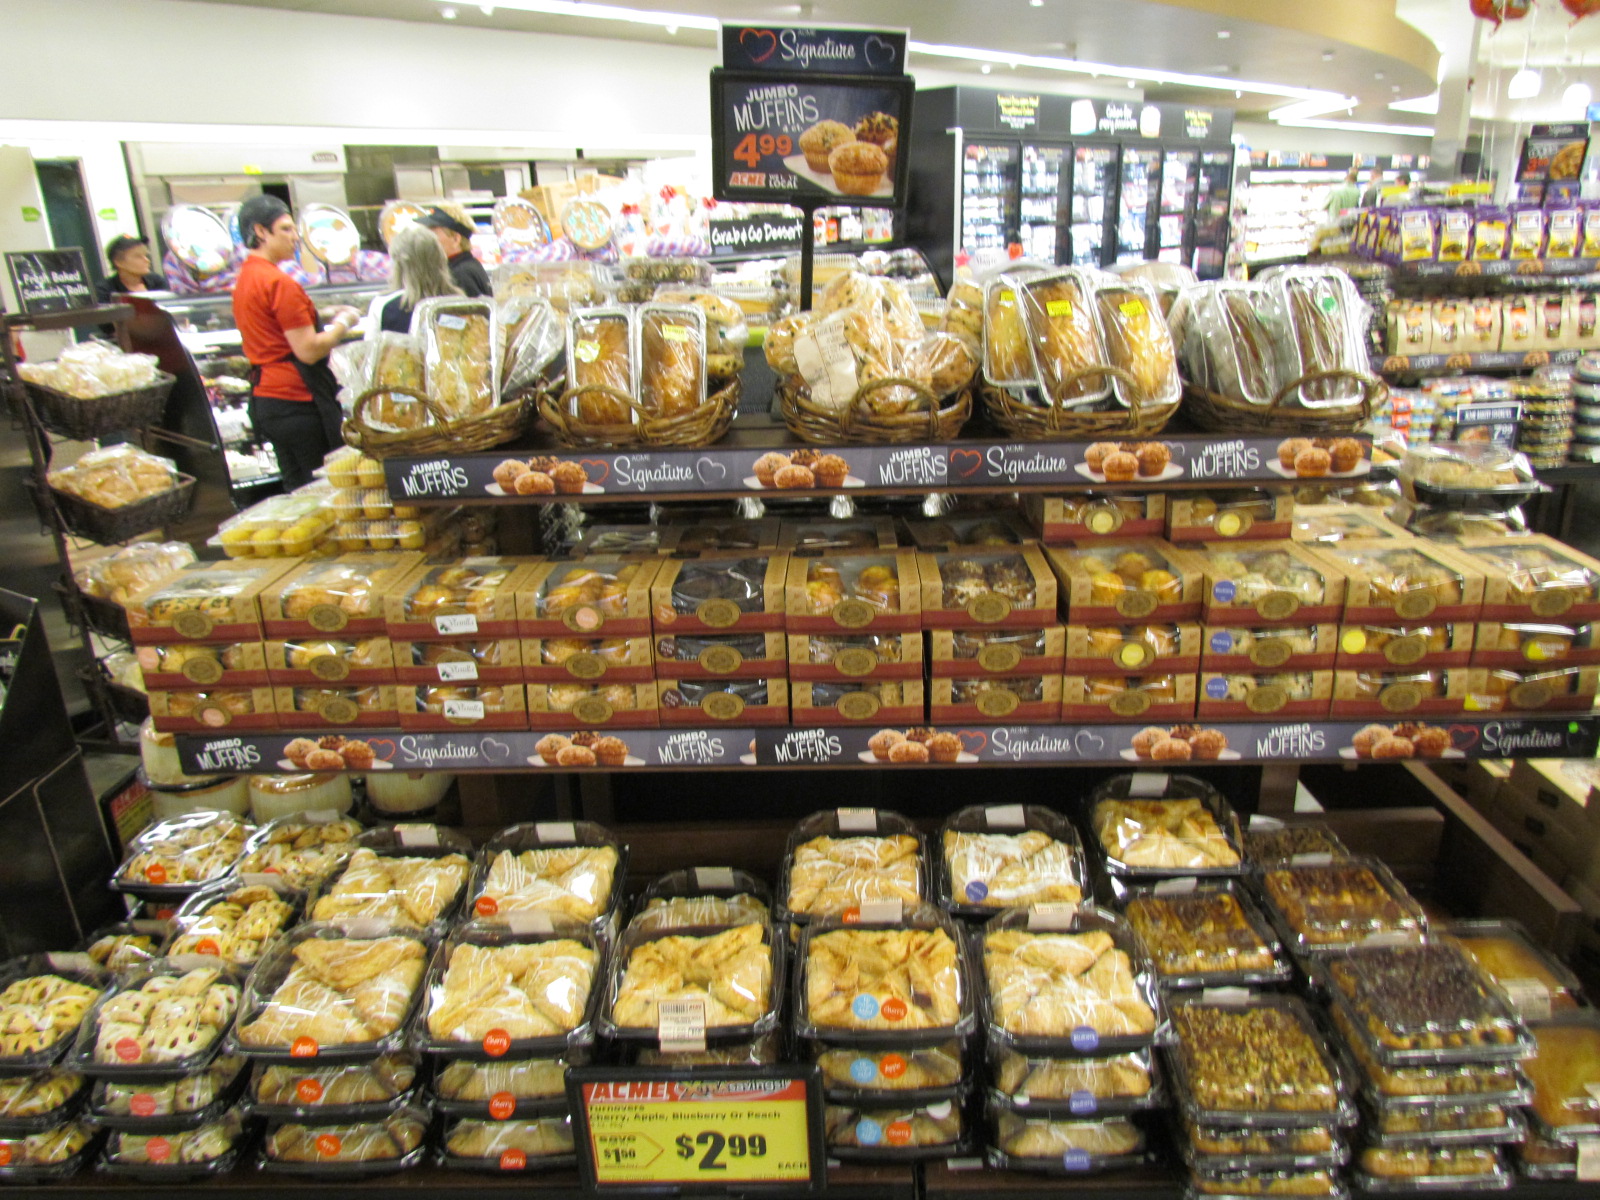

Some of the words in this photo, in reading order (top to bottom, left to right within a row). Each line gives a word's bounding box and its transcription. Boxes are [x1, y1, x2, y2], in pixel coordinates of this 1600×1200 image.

[779, 28, 856, 69] Signature
[745, 84, 798, 102] JUMBO
[733, 95, 819, 132] MUFFINS
[733, 133, 793, 167] 499
[712, 225, 740, 246] Grab
[748, 224, 762, 243] Go
[22, 272, 50, 286] Fresh
[51, 269, 82, 283] Baked
[890, 447, 931, 463] JUMBO
[1202, 439, 1244, 456] JUMBO
[411, 459, 450, 475] JUMBO
[614, 455, 693, 491] Signature
[879, 455, 947, 484] MUFFINS
[986, 446, 1067, 483] Signature
[1191, 447, 1260, 478] MUFFINS
[401, 467, 469, 496] MUFFINS
[667, 730, 707, 744] JUMBO
[784, 728, 825, 743] JUMBO
[1268, 722, 1311, 739] JUMBO
[1482, 721, 1562, 756] Signature
[204, 737, 242, 751] JUMBO
[400, 735, 479, 767] Signature
[657, 738, 725, 764] MUFFINS
[775, 736, 842, 763] MUFFINS
[992, 727, 1070, 761] Signature
[1257, 730, 1325, 758] MUFFINS
[196, 744, 261, 770] MUFFINS
[883, 1005, 904, 1017] Cherry
[296, 1043, 314, 1055] Apple
[486, 1035, 508, 1049] Cherry
[884, 1063, 901, 1074] Apple
[590, 1081, 670, 1102] ACME
[492, 1098, 513, 1110] Cherry
[588, 1104, 645, 1112] Turnovers
[588, 1112, 630, 1121] Cherry,
[633, 1112, 668, 1121] Apple,
[672, 1111, 726, 1120] Blueberry
[730, 1111, 742, 1119] Or
[747, 1111, 781, 1119] Peach
[674, 1131, 767, 1170] $299
